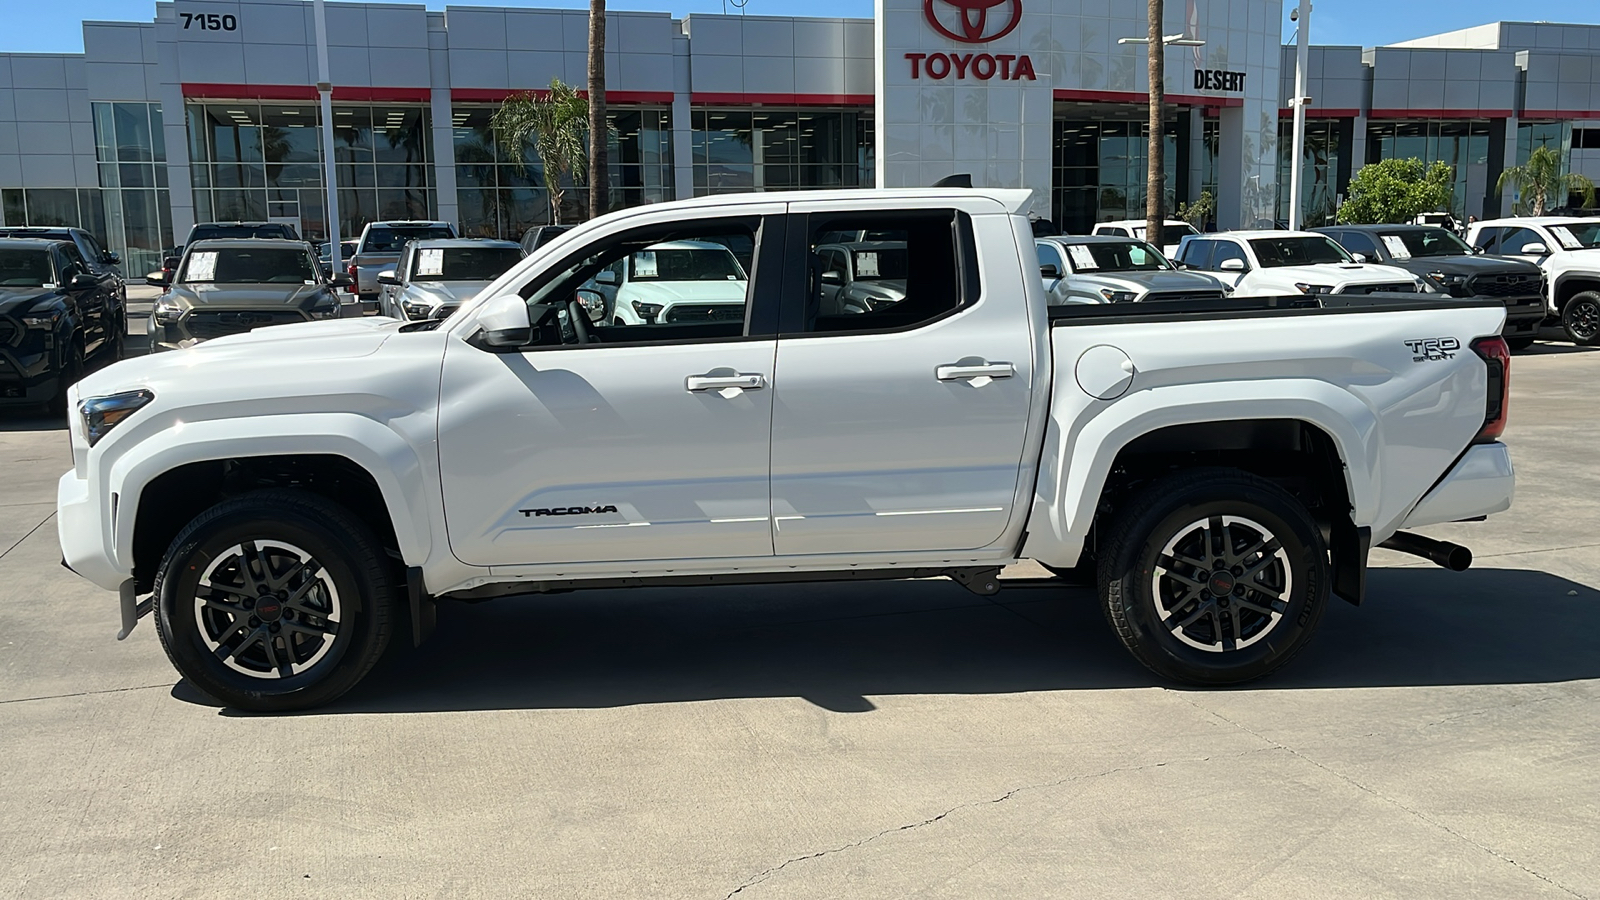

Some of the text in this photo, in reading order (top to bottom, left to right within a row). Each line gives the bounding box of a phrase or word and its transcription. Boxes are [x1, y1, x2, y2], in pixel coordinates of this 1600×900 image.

[179, 12, 237, 31] 7150
[904, 52, 1037, 80] TOYOTA
[1194, 69, 1246, 92] DESERT
[1403, 336, 1460, 358] TRD
[1412, 353, 1456, 362] SPORT
[518, 505, 618, 517] TACOMA
